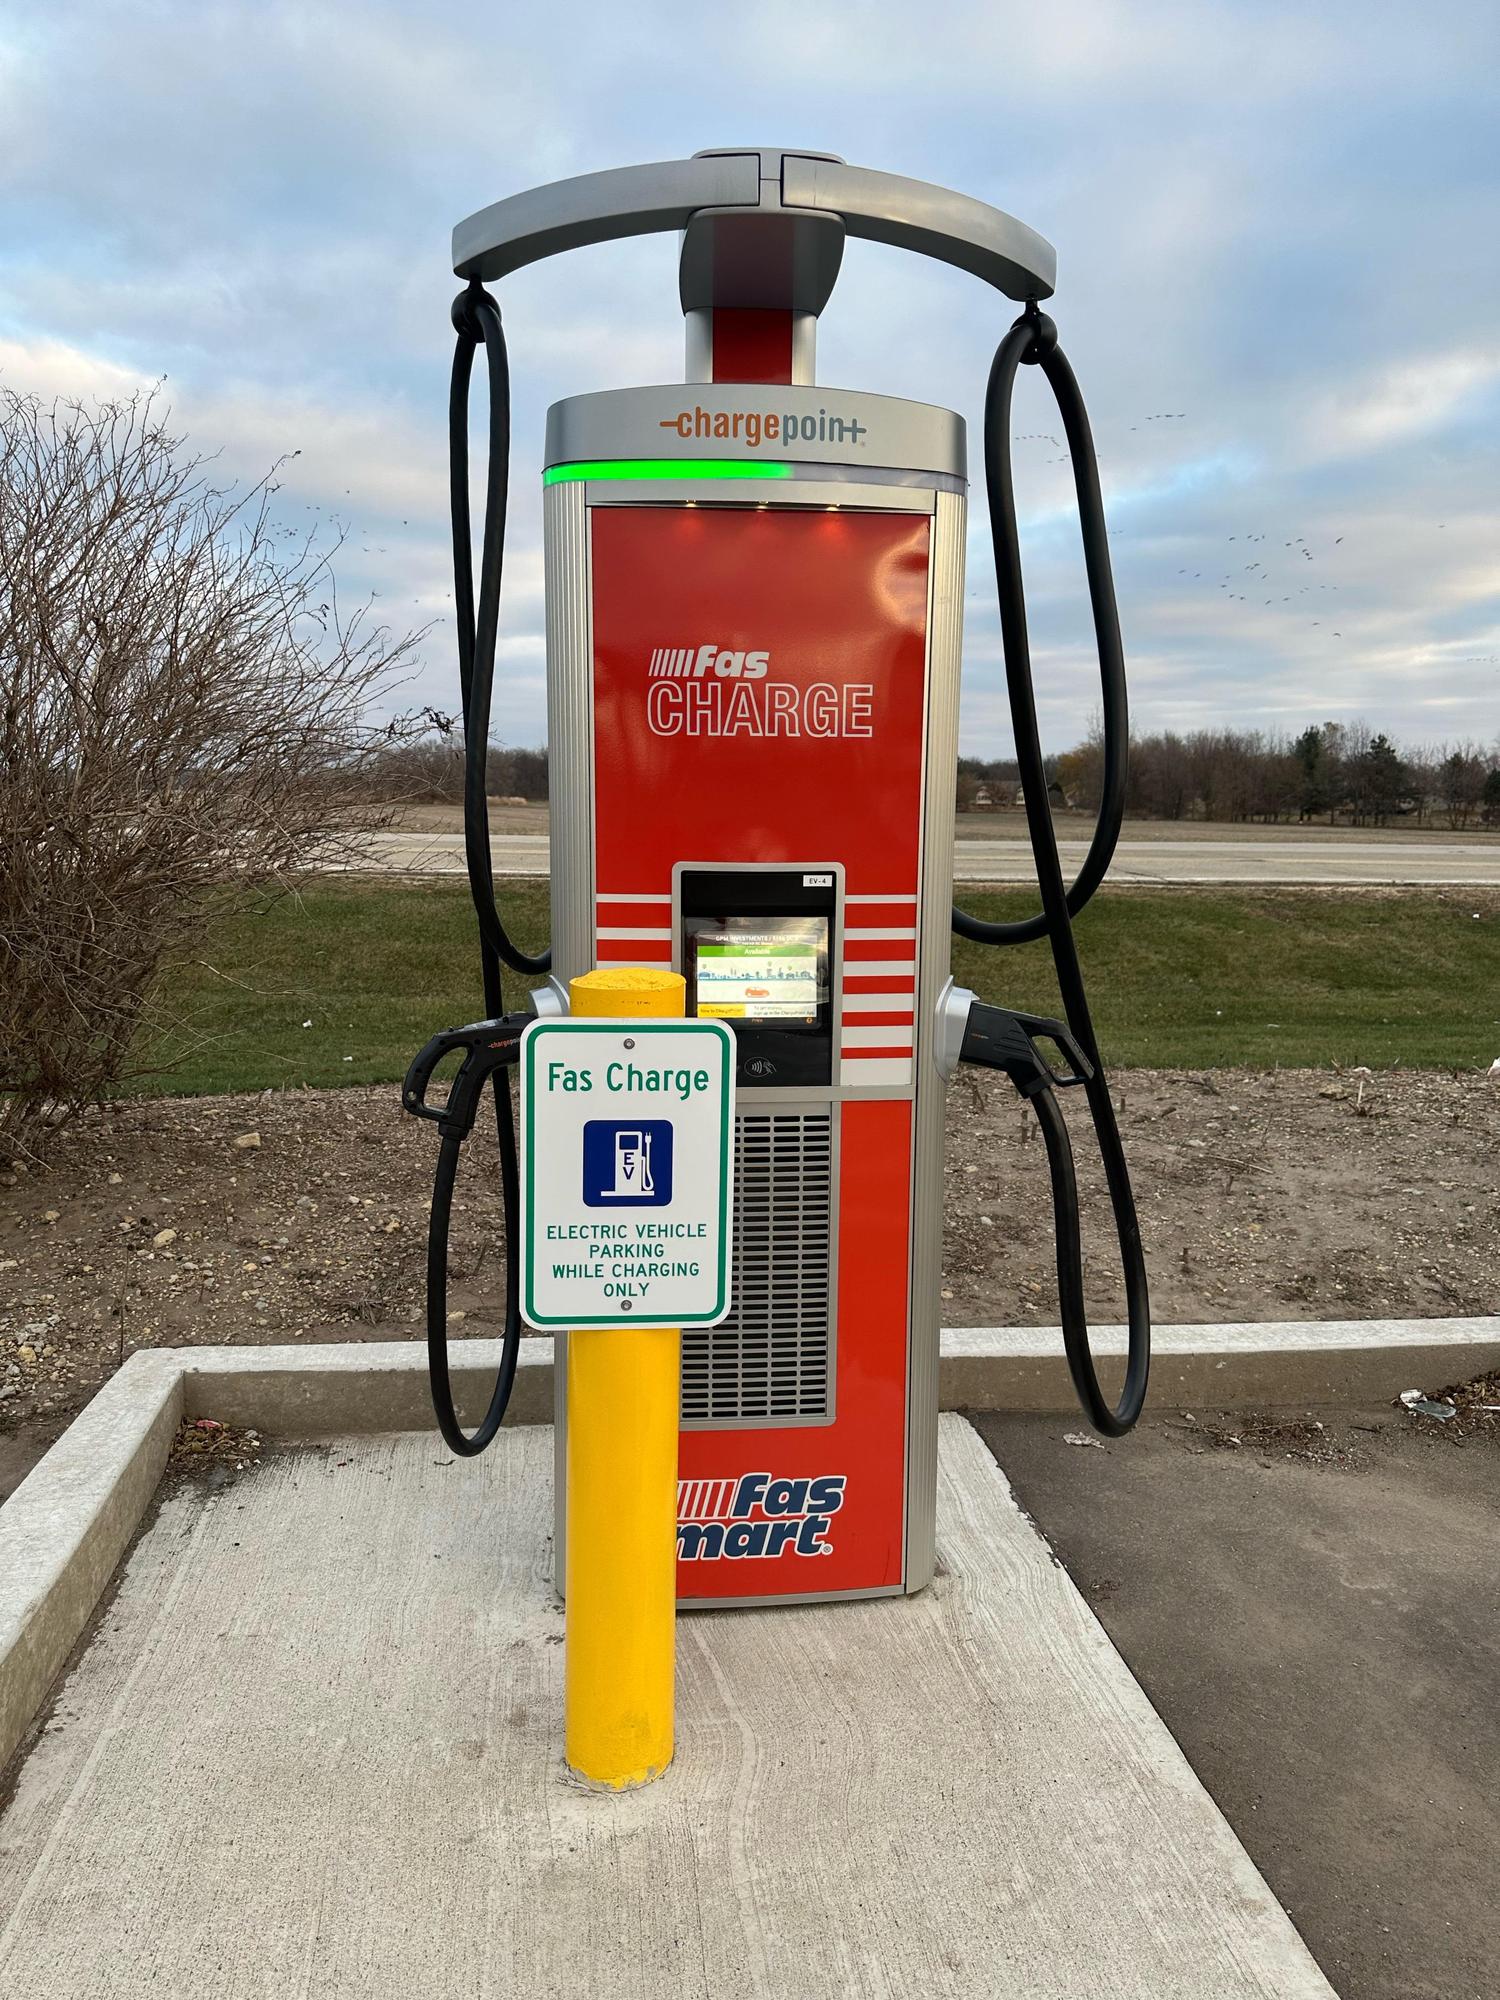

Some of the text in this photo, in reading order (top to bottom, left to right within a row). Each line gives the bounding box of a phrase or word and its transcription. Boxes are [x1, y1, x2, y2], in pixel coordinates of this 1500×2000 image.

[647, 680, 874, 738] CHARGE
[548, 1062, 710, 1100] Fas Charge
[547, 1223, 708, 1240] ELECTRIC VEHICLE
[589, 1243, 665, 1259] PARKING
[552, 1262, 700, 1279] WHILE CHARGING
[603, 1283, 650, 1298] ONLY
